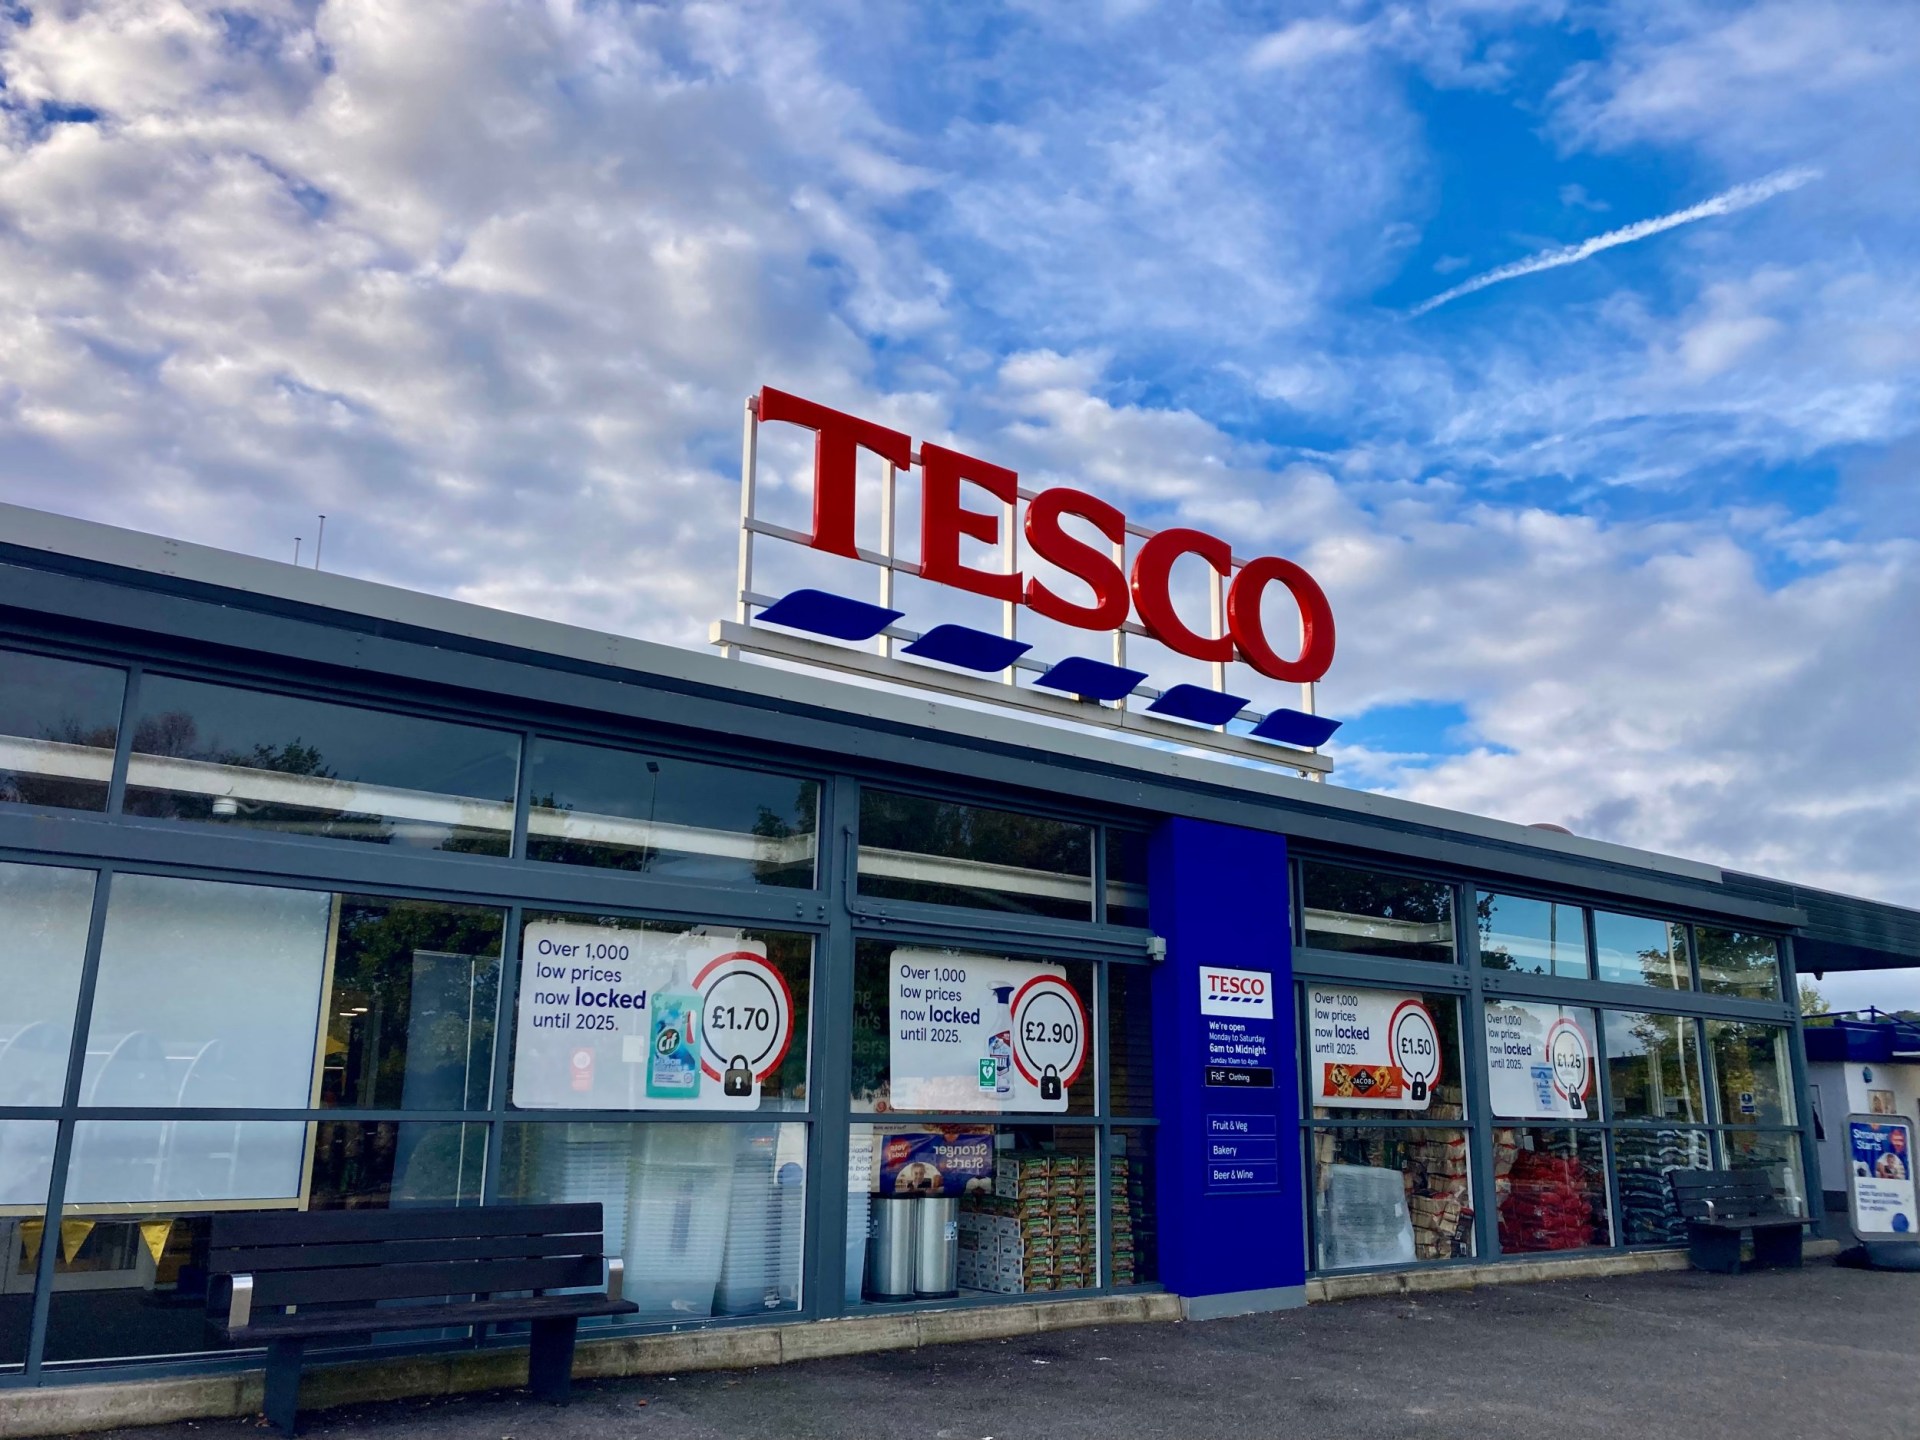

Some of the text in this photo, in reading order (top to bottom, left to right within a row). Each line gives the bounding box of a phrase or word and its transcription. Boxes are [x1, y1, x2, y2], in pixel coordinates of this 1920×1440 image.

[758, 385, 1336, 683] TESCO
[538, 939, 629, 961] Over 1,000
[536, 962, 622, 984] low prices
[900, 964, 966, 983] Over 1,000
[1207, 974, 1265, 996] TESCO
[534, 986, 647, 1010] now locked
[900, 984, 962, 1003] low prices
[1314, 992, 1358, 1006] Over 1,000
[533, 1013, 619, 1031] until 2025.
[712, 1006, 770, 1031] £1.70
[900, 1009, 926, 1021] now
[929, 1005, 980, 1025] locked
[1314, 1008, 1357, 1023] low prices
[1487, 1013, 1522, 1026] Over 1,000
[1025, 1021, 1074, 1044] £2.90
[1209, 1021, 1246, 1033] We're open
[1315, 1024, 1370, 1040] now locked
[1488, 1028, 1521, 1041] low prices
[658, 1032, 678, 1052] Cif
[900, 1028, 962, 1043] until 2025.
[1209, 1032, 1231, 1043] Monday
[1239, 1034, 1265, 1044] Saturday
[1209, 1043, 1267, 1057] 6am to Midnight
[1315, 1043, 1358, 1056] until 2025.
[1401, 1037, 1432, 1056] £1.50
[1489, 1042, 1532, 1056] now locked
[1210, 1056, 1228, 1065] Sunday
[1490, 1058, 1524, 1070] until 2025.
[1557, 1054, 1581, 1069] £1.25
[1211, 1071, 1250, 1083] F&F Clothing
[1212, 1120, 1248, 1132] Fruit & Veg
[1213, 1145, 1237, 1157] Bakery
[1213, 1169, 1254, 1180] Beer & Wine
